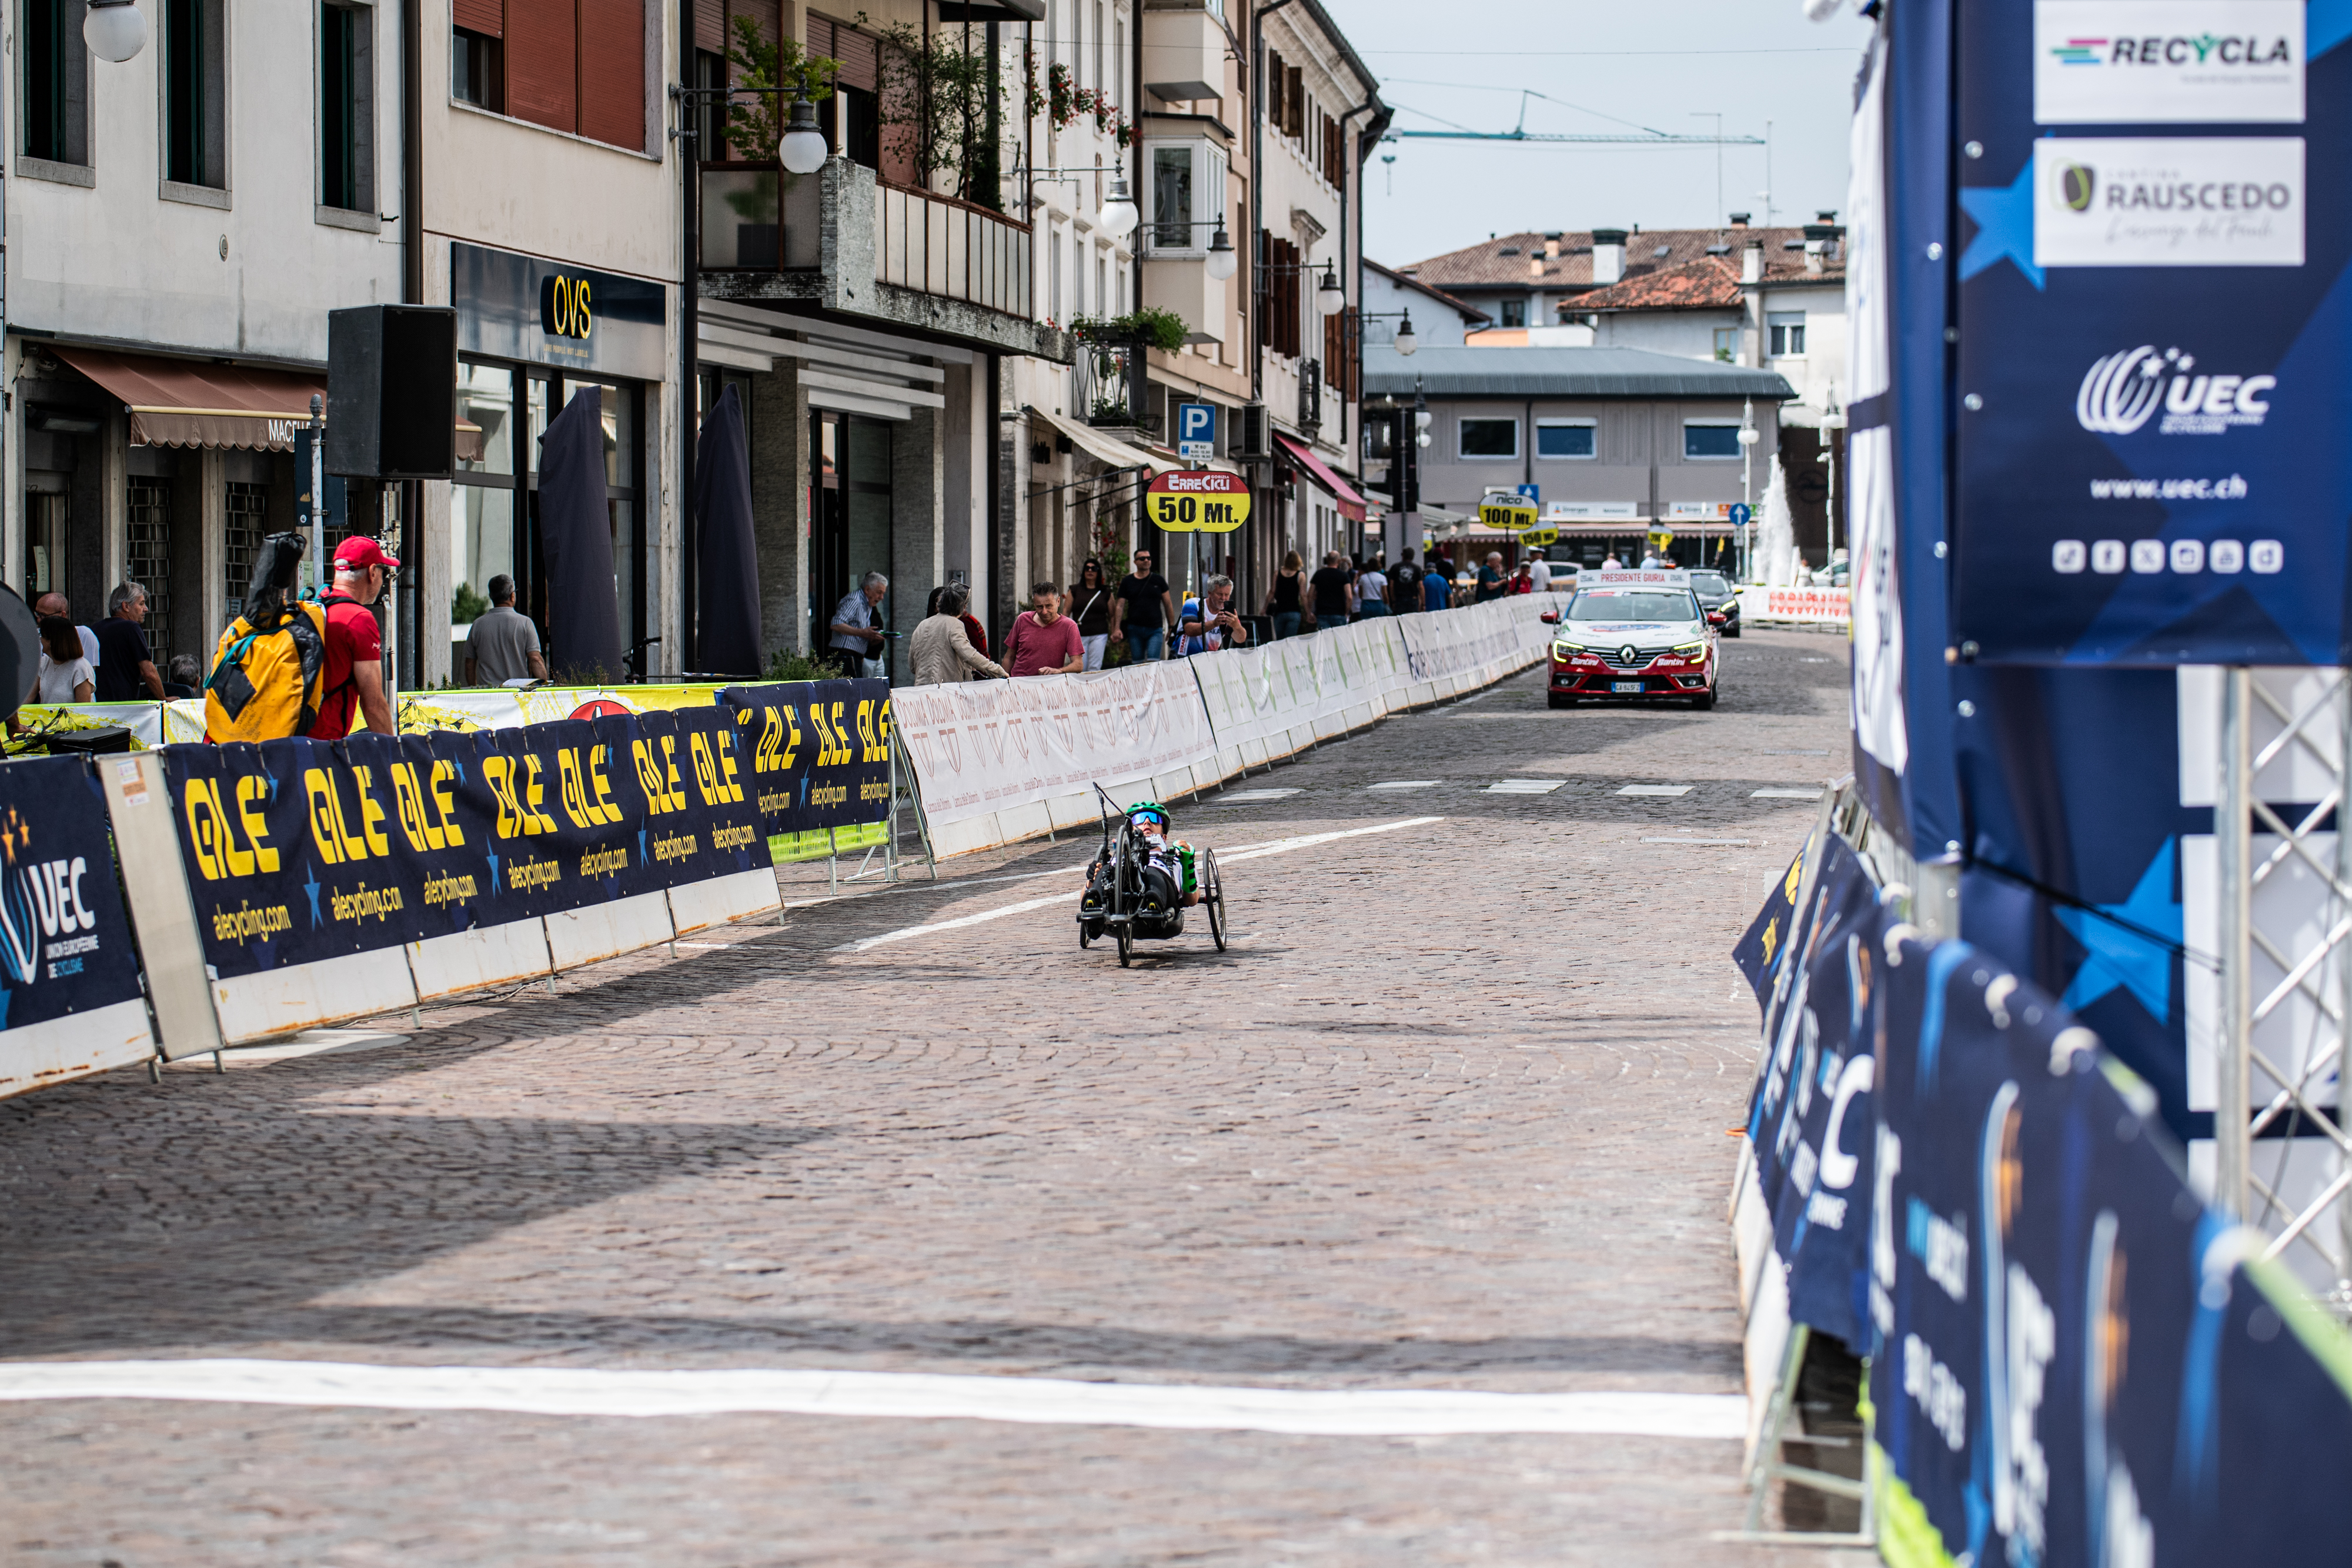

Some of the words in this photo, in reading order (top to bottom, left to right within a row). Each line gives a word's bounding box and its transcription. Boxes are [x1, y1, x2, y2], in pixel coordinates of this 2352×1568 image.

[2110, 33, 2291, 66] RECYCLA
[2106, 183, 2291, 212] RAUSCEDO
[554, 275, 592, 339] OVS
[2166, 375, 2277, 413] UEC
[1186, 408, 1208, 437] P
[1496, 495, 1523, 504] nico
[2090, 473, 2247, 499] www.uec.ch
[1158, 497, 1196, 523] 50
[1205, 503, 1239, 523] Mt.
[1484, 508, 1511, 524] 100
[1601, 573, 1641, 582] PRESIDENTE
[1643, 573, 1665, 582] GIURIA
[1570, 657, 1600, 666] Santini
[1656, 658, 1686, 666] Santini
[758, 787, 790, 818] lecycling.com
[811, 780, 847, 810] alecycling.com
[508, 854, 560, 894] alecycling.com
[581, 843, 627, 881] alecycling.com
[653, 830, 697, 865] alecycling.com
[712, 820, 756, 853] alecycling.com
[28, 857, 95, 937] UEC
